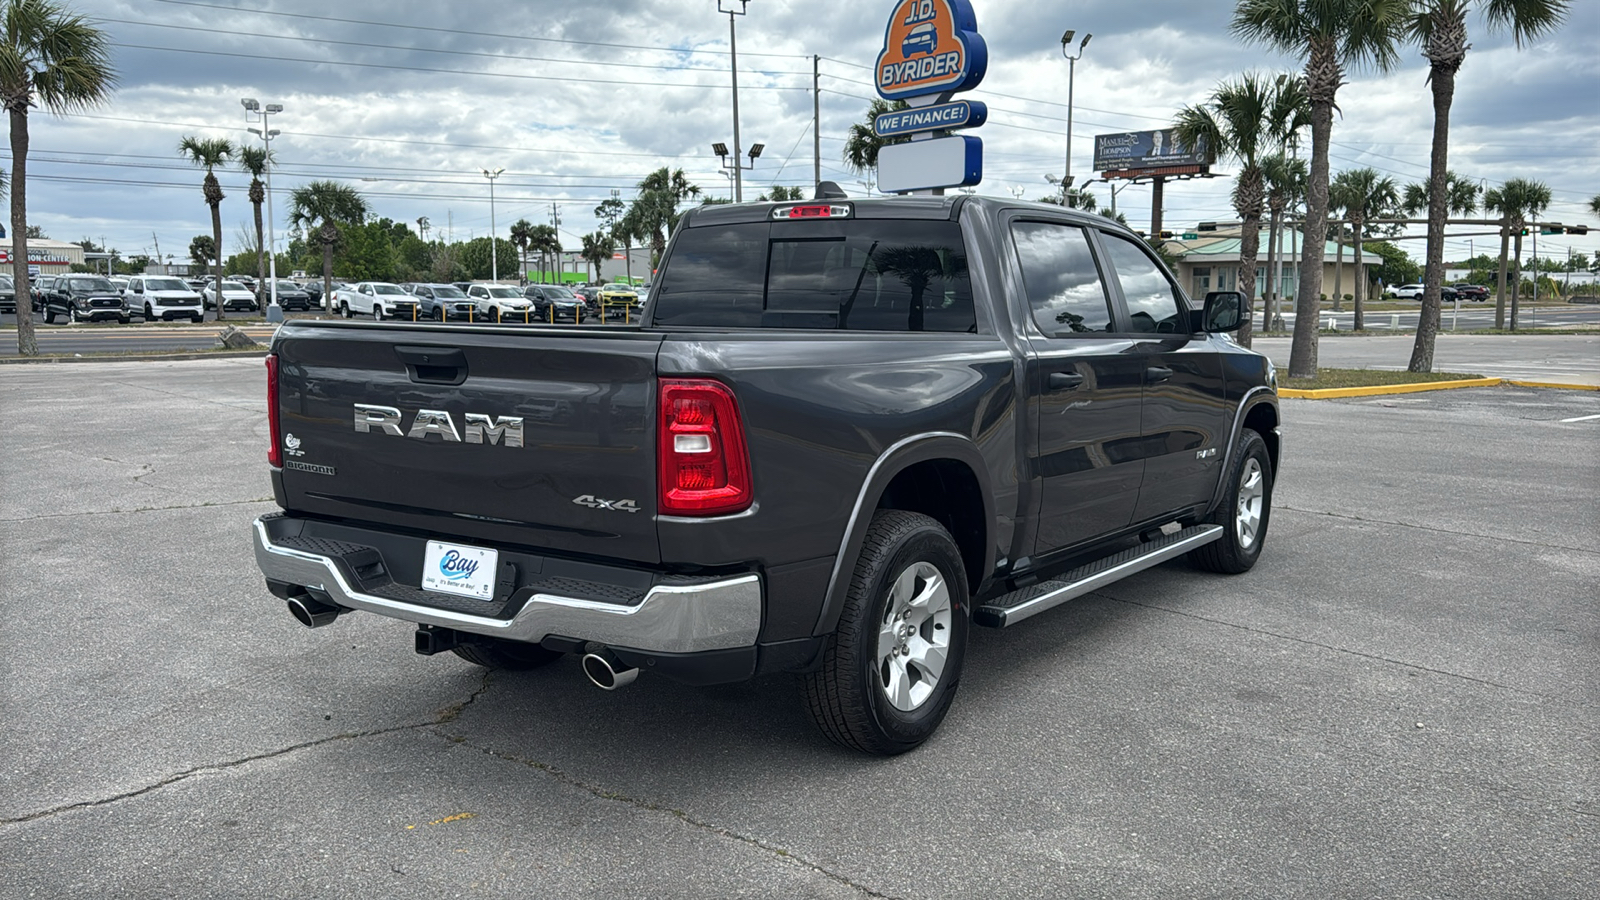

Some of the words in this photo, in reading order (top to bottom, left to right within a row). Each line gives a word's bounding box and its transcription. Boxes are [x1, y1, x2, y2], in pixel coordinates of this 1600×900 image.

[881, 52, 960, 86] BYRIDER
[880, 117, 899, 131] WE
[901, 106, 964, 128] FINANCE!
[354, 403, 524, 448] RAM
[442, 549, 479, 579] Bay
